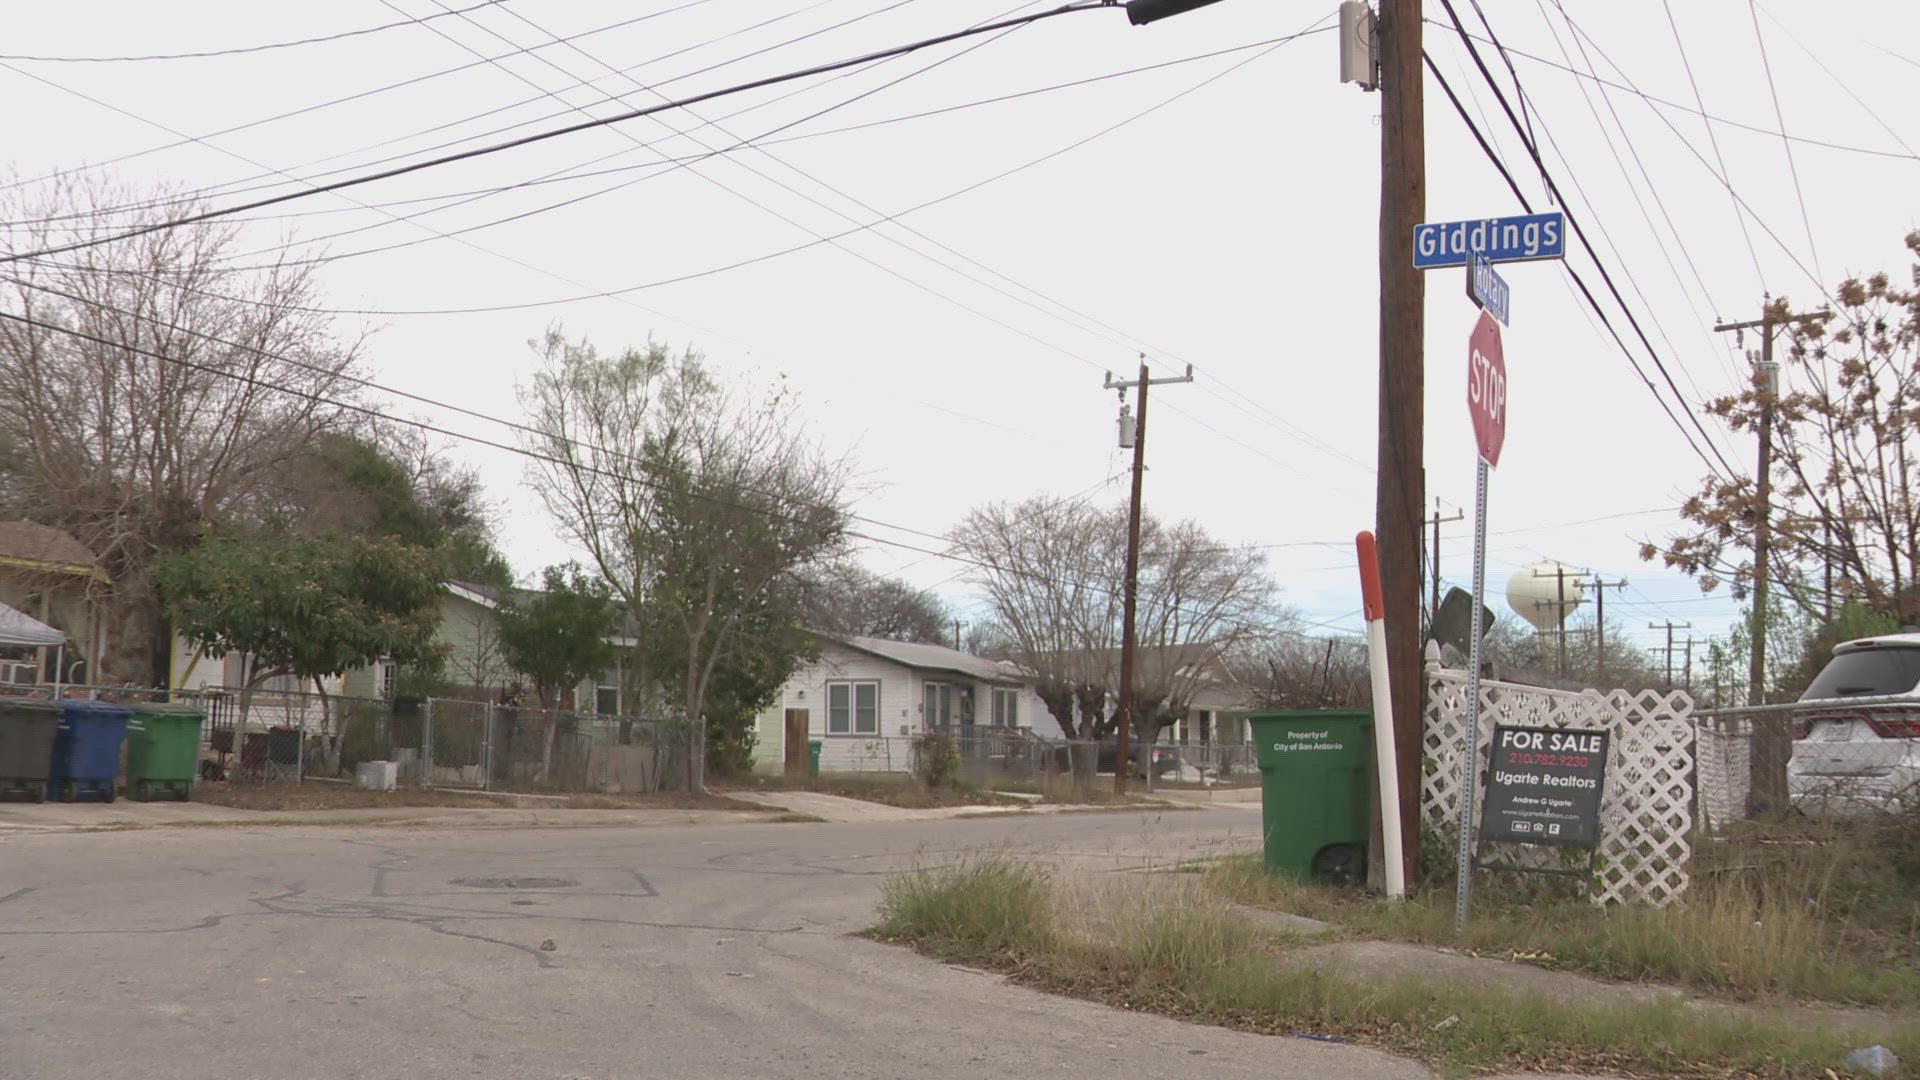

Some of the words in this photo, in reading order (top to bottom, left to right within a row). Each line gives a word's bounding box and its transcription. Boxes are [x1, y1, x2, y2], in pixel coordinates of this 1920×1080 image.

[1418, 220, 1557, 257] Giddings
[1477, 255, 1508, 322] Rotary
[1471, 349, 1505, 424] STOP
[1288, 731, 1319, 740] Property
[1502, 731, 1544, 749] FOR
[1549, 733, 1601, 752] SALE
[1273, 743, 1289, 752] City
[1289, 743, 1298, 751] of
[1298, 743, 1313, 751] San
[1314, 743, 1343, 751] Antonio
[1495, 771, 1539, 785] Ugarte
[1543, 774, 1596, 788] Realtors
[1512, 796, 1539, 804] Andrew
[1548, 799, 1572, 807] Ugarte
